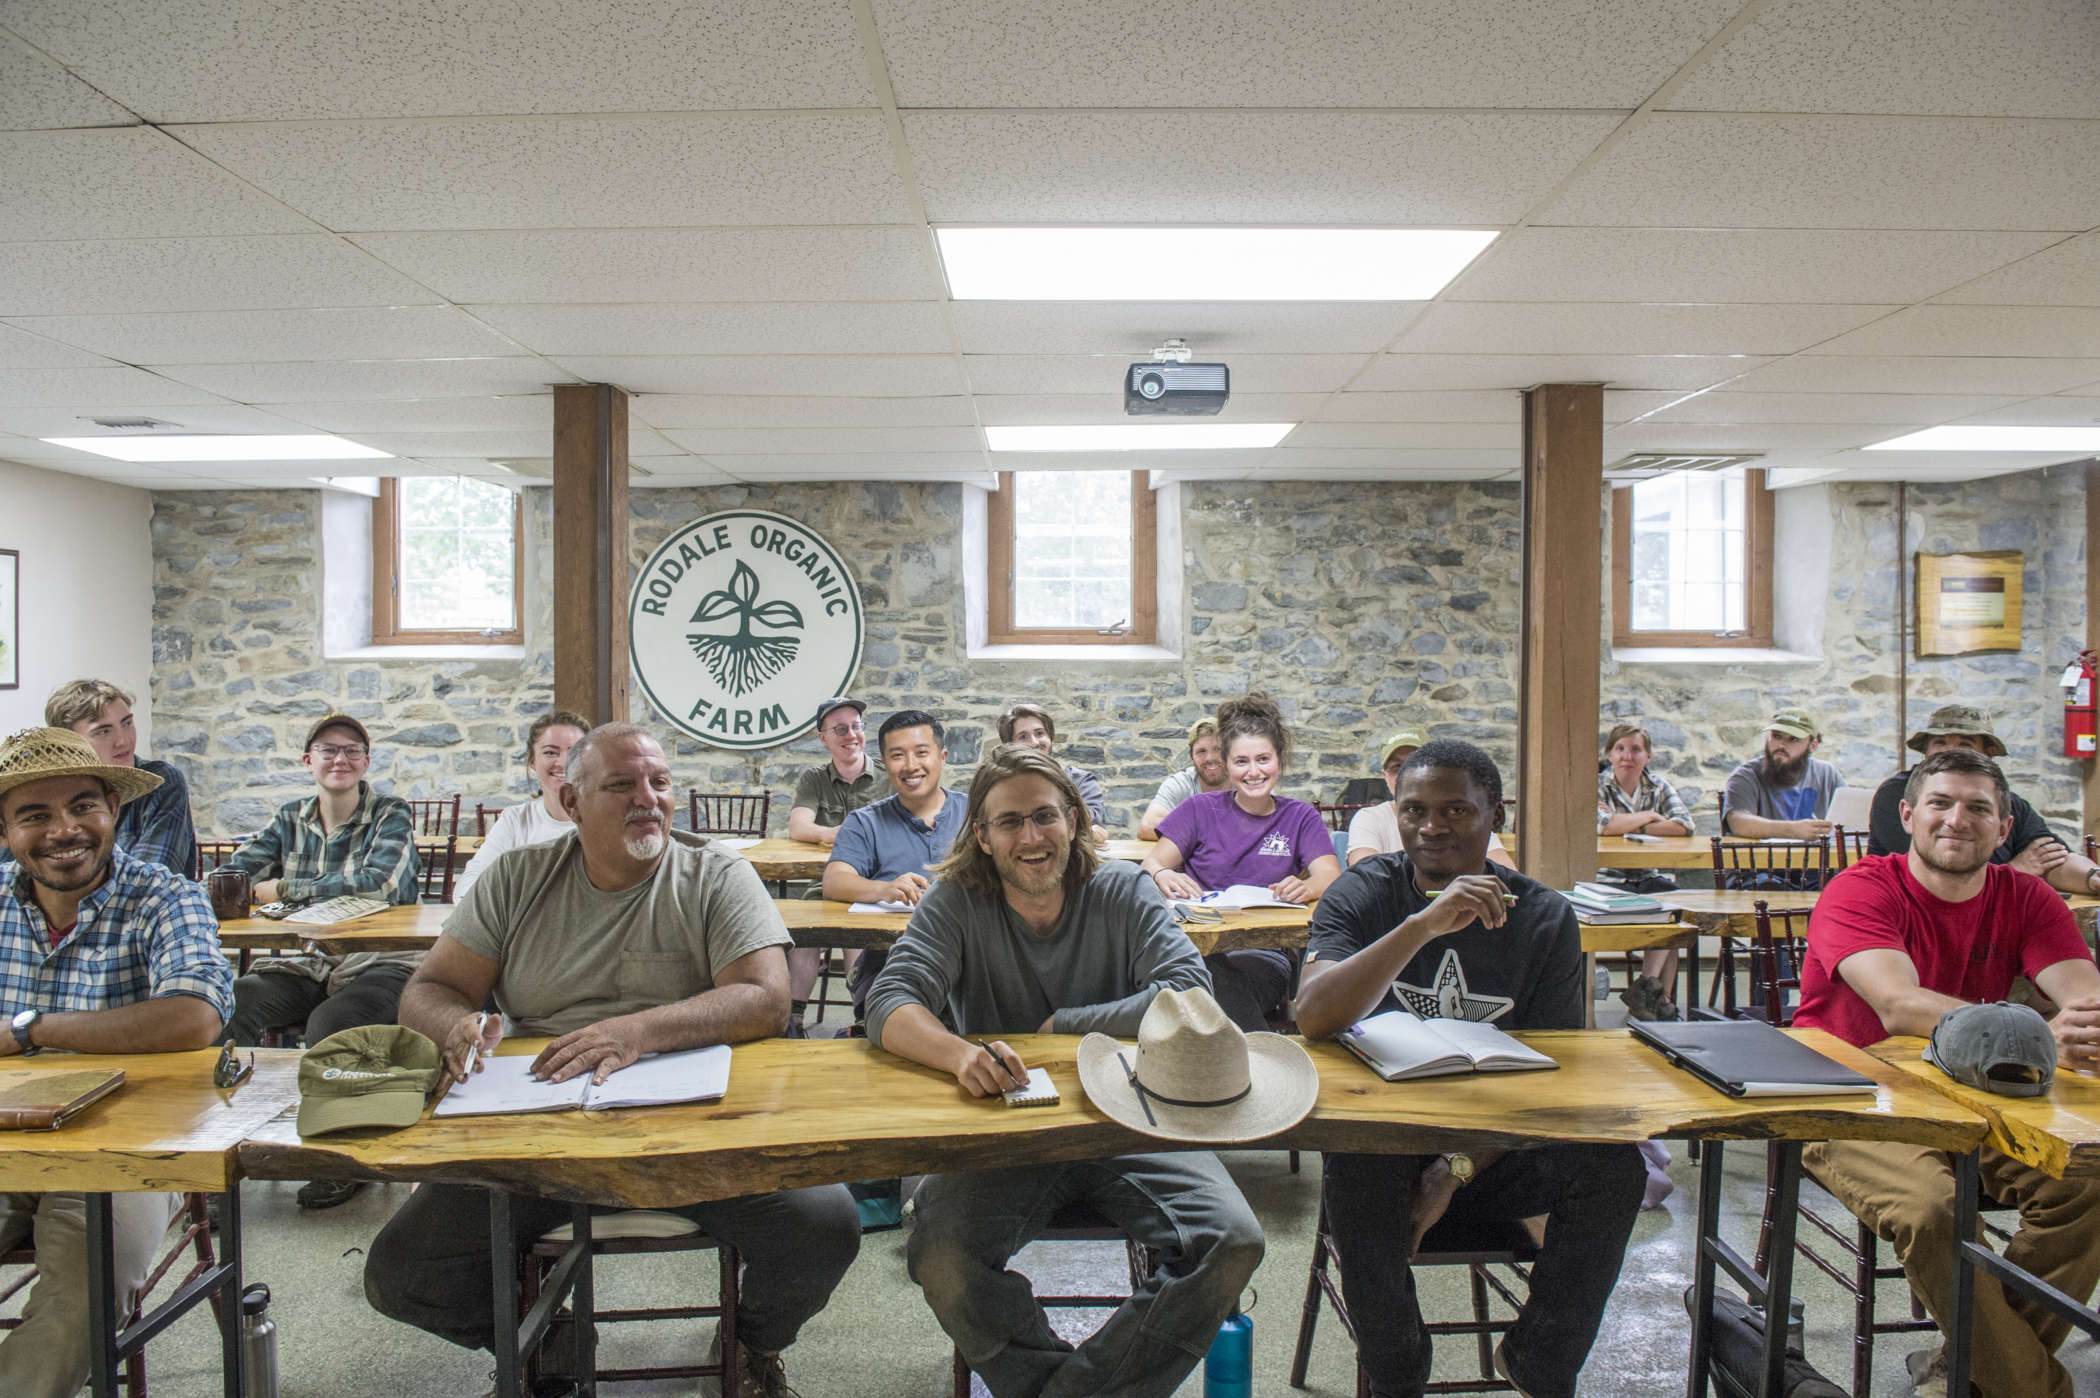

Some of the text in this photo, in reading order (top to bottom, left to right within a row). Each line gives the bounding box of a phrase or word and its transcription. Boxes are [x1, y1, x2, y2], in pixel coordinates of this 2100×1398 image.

[641, 524, 848, 618] RODALE ORGANIC
[688, 698, 791, 735] FARM
